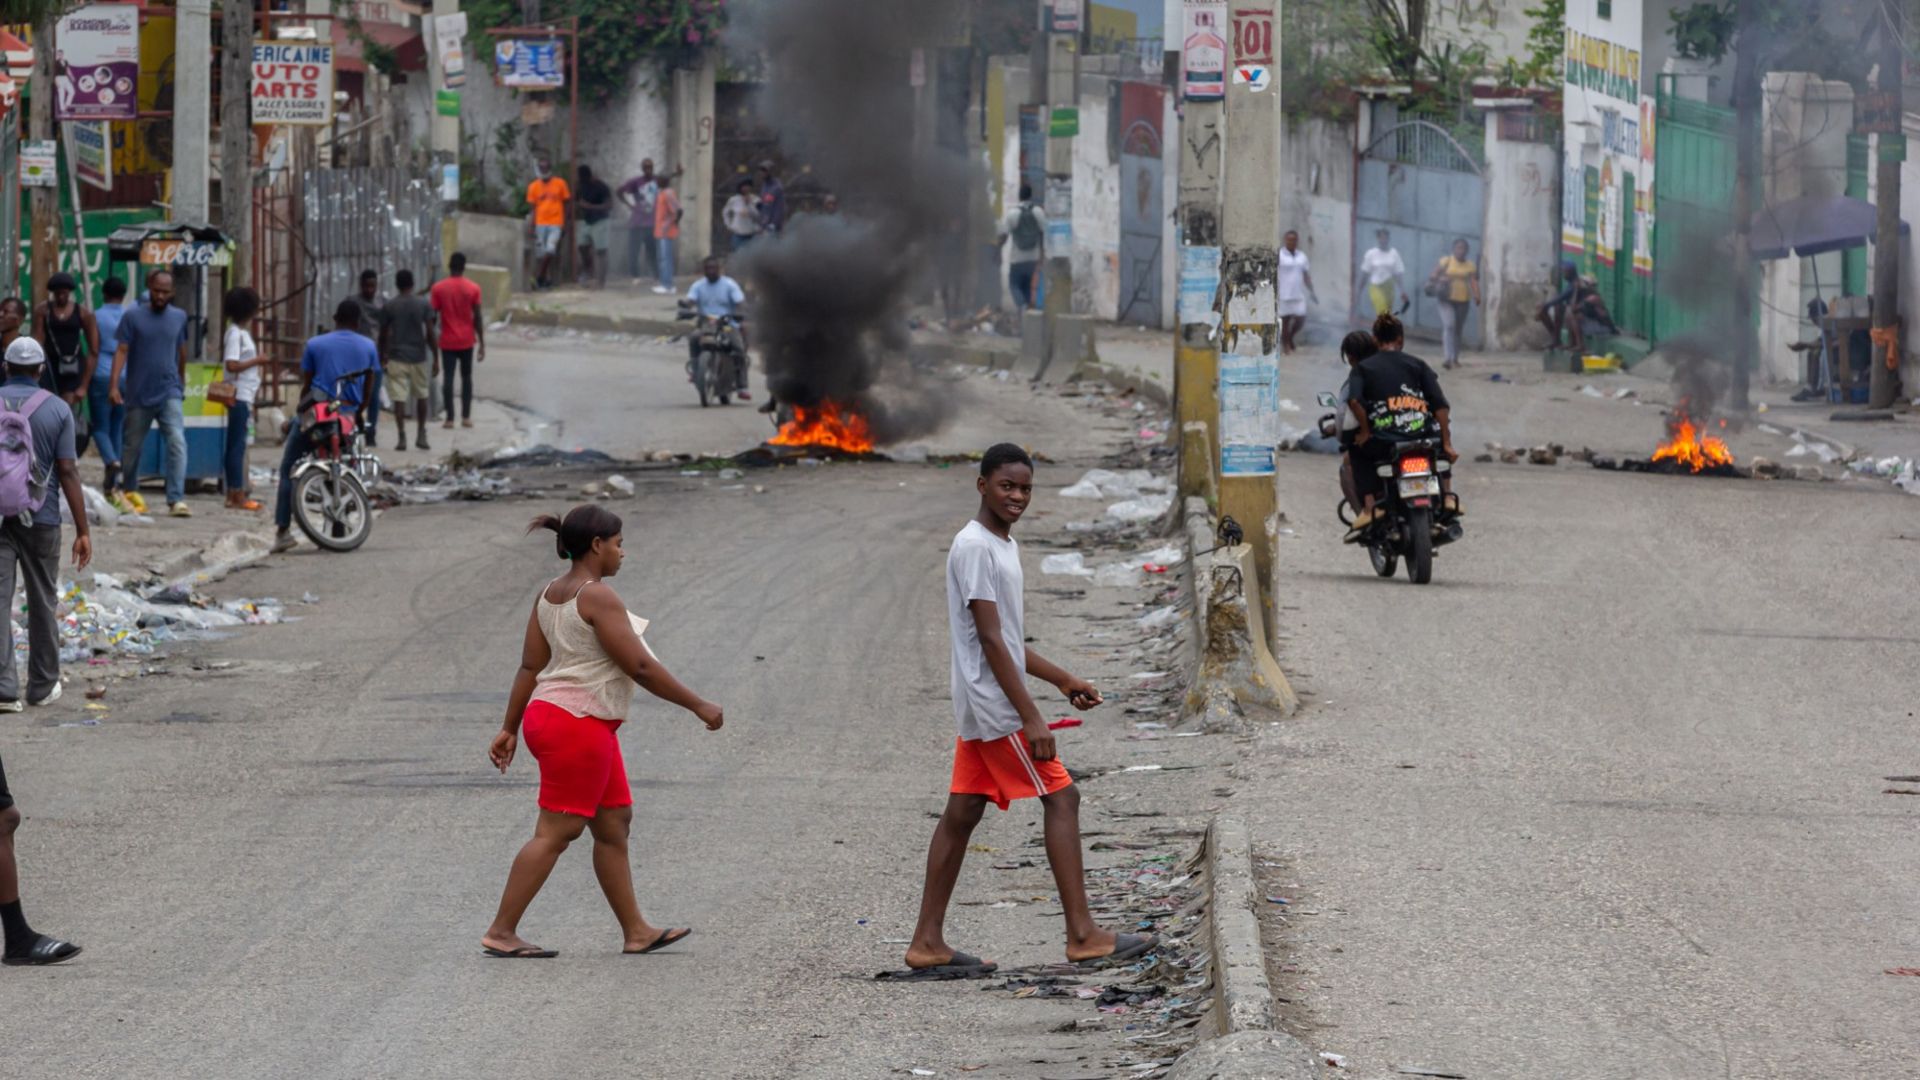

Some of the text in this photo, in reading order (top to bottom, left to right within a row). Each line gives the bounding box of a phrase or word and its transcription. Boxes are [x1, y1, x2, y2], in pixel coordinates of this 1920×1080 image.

[252, 46, 331, 64] ERICAINE
[253, 64, 320, 80] UTO
[252, 82, 318, 98] ARTS
